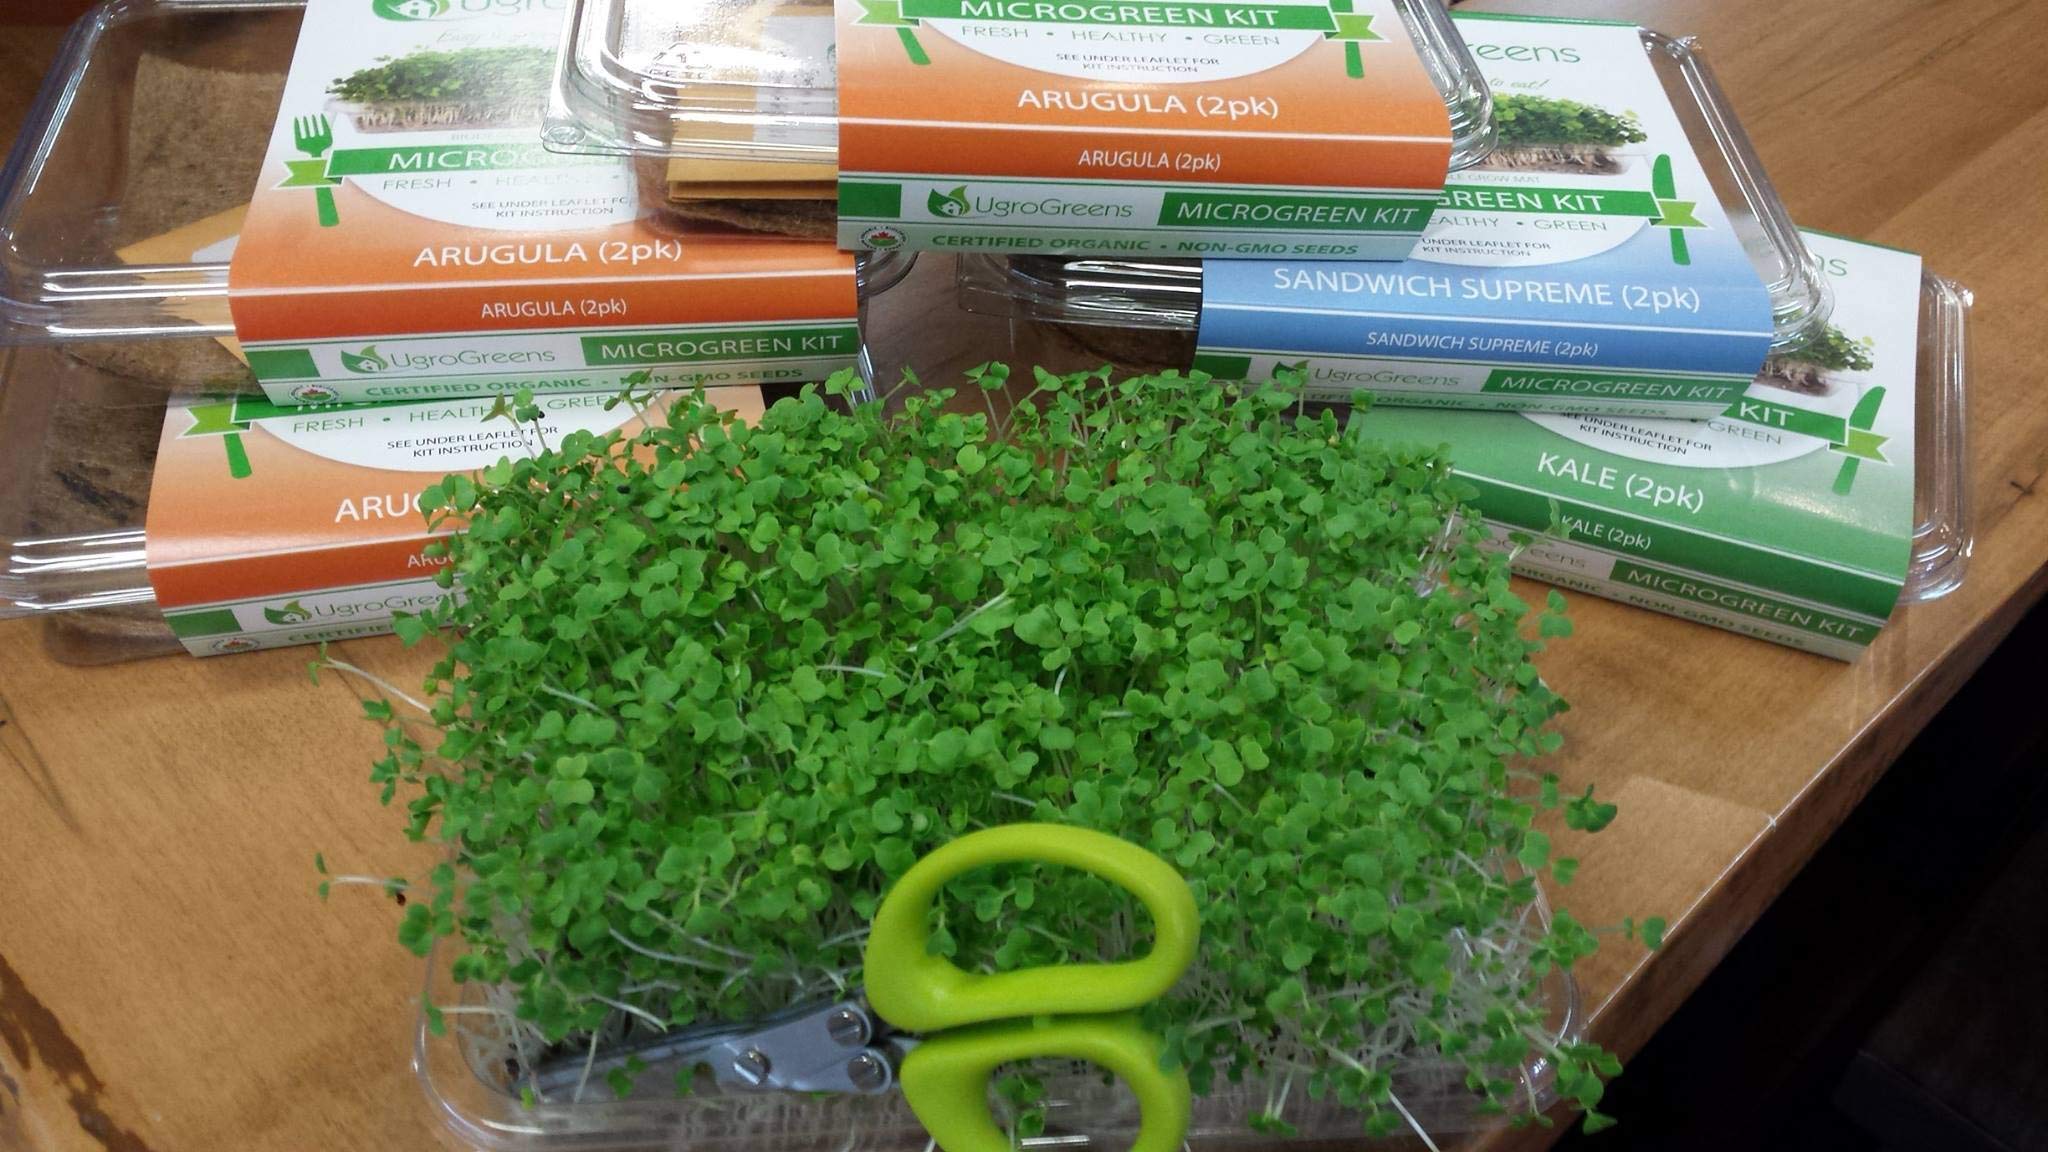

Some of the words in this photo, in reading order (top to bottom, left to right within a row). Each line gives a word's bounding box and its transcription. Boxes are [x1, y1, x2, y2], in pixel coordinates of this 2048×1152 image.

[960, 1, 1213, 25] MICROGREEN
[1225, 9, 1279, 26] KIT
[961, 26, 1029, 39] FRESH
[1071, 29, 1167, 43] HEALTHY
[1203, 33, 1280, 46] GREEN
[1056, 53, 1079, 61] SEE
[1083, 54, 1130, 63] UNDER
[1133, 55, 1188, 64] LEAFLET
[1193, 57, 1220, 65] FOR
[1105, 64, 1198, 73] INSTRUCTION
[1017, 89, 1188, 114] ARUGULA
[1196, 95, 1279, 121] (2pk)
[1077, 149, 1169, 168] ARUGULA
[1175, 153, 1221, 173] (2pk)
[383, 178, 452, 191] FRESH
[471, 201, 496, 210] SEE
[499, 199, 549, 209] UNDER
[552, 198, 607, 207] LEAFLET
[496, 211, 516, 219] KIT
[519, 207, 614, 218] INSTRUCTION
[974, 195, 1133, 218] UgroGreens
[1176, 201, 1361, 223] MICROGREEN
[1372, 207, 1420, 224] KIT
[1553, 193, 1604, 212] KIT
[1534, 219, 1607, 231] GREEN
[412, 242, 588, 268] ARUGULA
[598, 239, 682, 266] (2pk)
[932, 234, 1044, 248] CERTIFIED
[1049, 237, 1150, 250] ORGANIC
[1178, 242, 1287, 255] NON-GMO
[1290, 244, 1359, 255] SEEDS
[1421, 237, 1467, 247] UNDER
[1469, 240, 1522, 248] LEAFLET
[1525, 242, 1551, 250] FOR
[1444, 247, 1531, 257] INSTRUCTION
[1273, 267, 1451, 298] SANDWICH
[1460, 278, 1614, 305] SUPREME
[1622, 284, 1700, 314] (2pk)
[480, 299, 576, 319] ARUGULA
[580, 297, 628, 317] (2pk)
[390, 348, 555, 370] UgroGreens
[600, 337, 792, 360] MICROGREEN
[801, 335, 844, 352] KIT
[1366, 331, 1465, 350] SANDWICH
[1467, 336, 1551, 354] SUPREME
[1554, 341, 1599, 359] (2pk)
[365, 382, 481, 397] CERTIFIED
[486, 377, 591, 391] ORGANIC
[737, 367, 803, 379] SEEDS
[1314, 367, 1461, 387] UgroGreens
[1499, 376, 1685, 398] MICROGREEN
[1687, 386, 1733, 400] KIT
[293, 416, 364, 433] FRESH
[409, 404, 491, 423] HEALTH
[547, 395, 624, 410] GREE
[1739, 401, 1795, 427] KIT
[387, 440, 412, 449] SEE
[415, 434, 465, 447] UNDER
[468, 429, 527, 443] LEAFLET
[530, 427, 558, 437] FOR
[1579, 423, 1599, 434] KIT
[1601, 429, 1688, 455] INSTRUCTION
[1583, 415, 1636, 432] UNDER
[1636, 427, 1684, 443] LEAFLET
[1685, 439, 1713, 451] FOR
[1707, 420, 1783, 445] GREEN
[413, 448, 435, 458] KIT
[437, 440, 533, 455] INSTRUCTION
[1537, 452, 1618, 490] KALE
[1625, 473, 1704, 514] (2pk)
[1561, 514, 1605, 538] KALE
[1606, 527, 1652, 551] (2pk)
[1626, 569, 1812, 626] MICROGREEN
[1818, 618, 1864, 639] KIT
